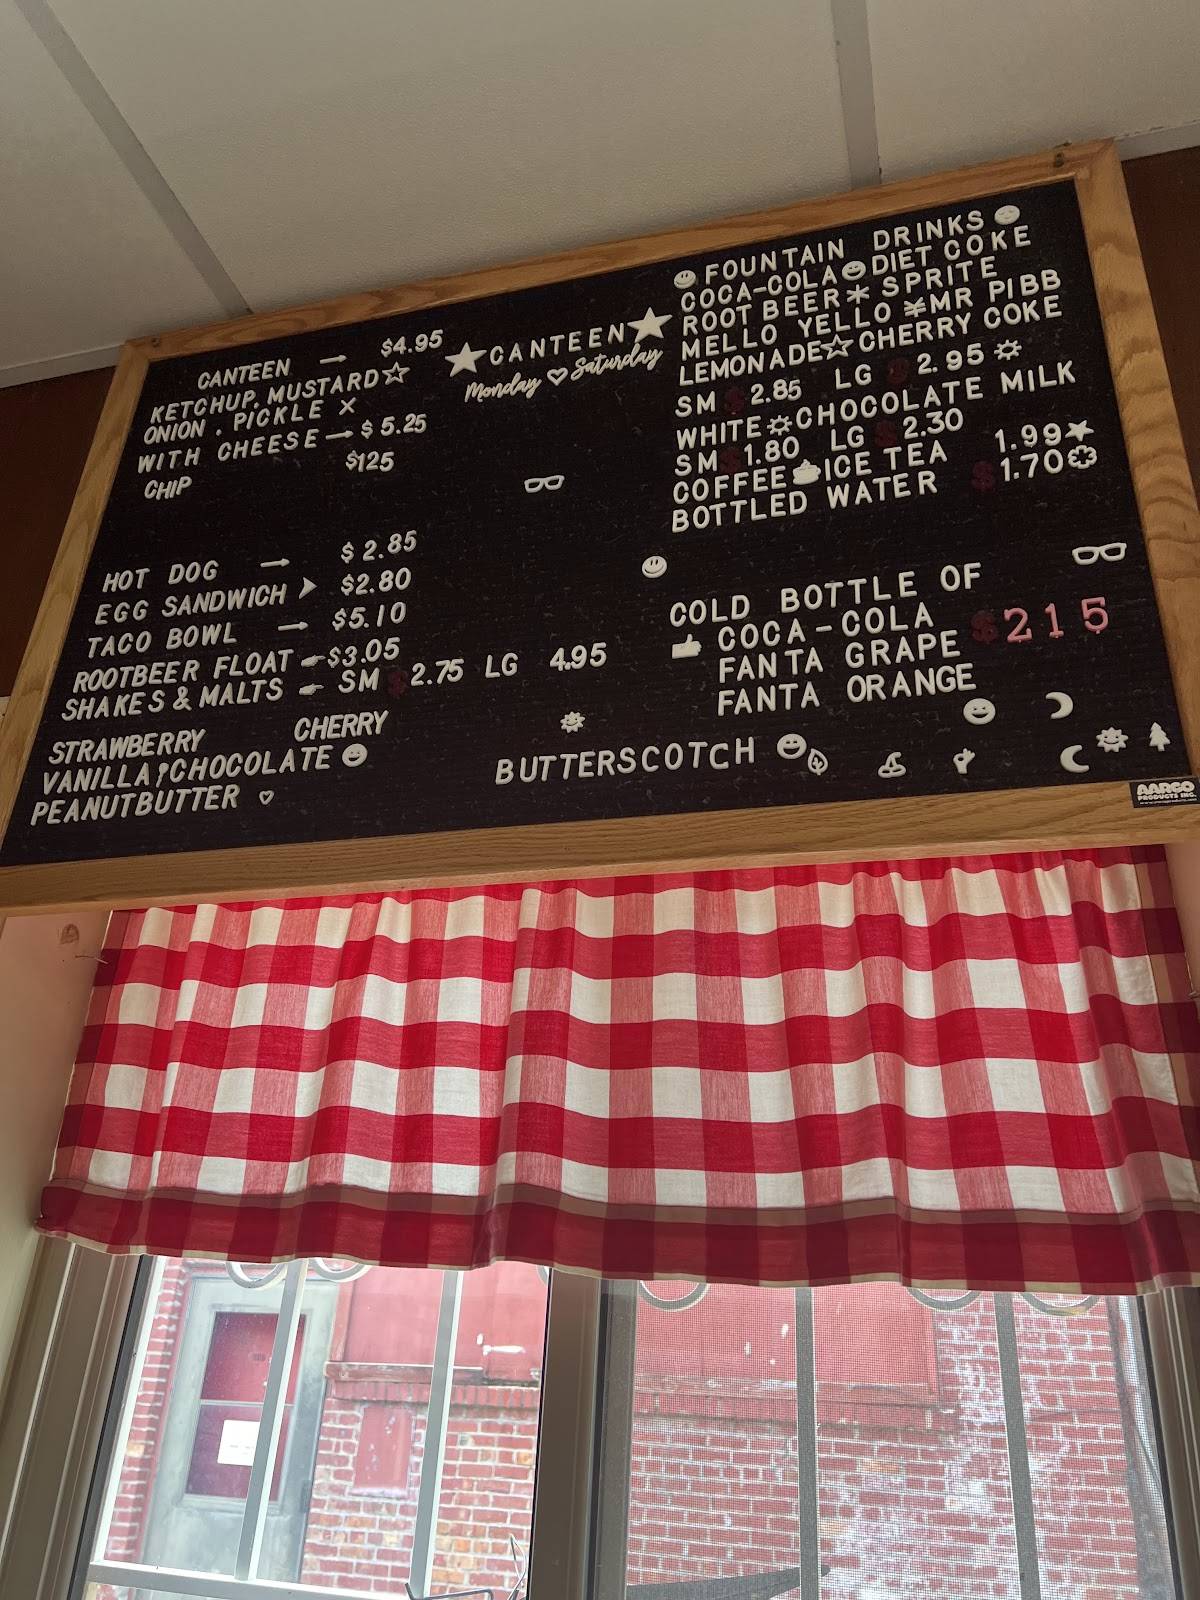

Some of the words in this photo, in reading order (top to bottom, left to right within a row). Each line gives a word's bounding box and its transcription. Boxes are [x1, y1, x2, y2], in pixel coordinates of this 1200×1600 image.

[680, 264, 838, 313] COCA-COLA
[871, 245, 932, 276] DIET
[943, 224, 1031, 261] COKE
[705, 238, 844, 285] FOUNTAIN
[873, 209, 985, 251] DRINKS
[681, 323, 778, 362] MELLO
[797, 301, 892, 338] YELLO
[930, 286, 974, 314] MR
[988, 268, 1061, 303] PIBB
[682, 303, 752, 337] ROOT
[762, 288, 840, 322] BEER
[881, 255, 998, 298] SPRITE
[489, 322, 625, 366] CANTEEN
[679, 340, 823, 387] LEMONADE
[858, 311, 971, 353] CHERRY
[983, 294, 1063, 330] COKE
[197, 358, 291, 390] CANTEEN
[268, 368, 379, 404] MUSTARD
[464, 371, 542, 403] Monday
[570, 342, 663, 382] Saturday
[674, 390, 716, 418] SM
[750, 378, 802, 406] 2.85
[835, 363, 873, 390] LG
[916, 342, 985, 375] 2.95
[143, 419, 206, 445] ONION
[233, 399, 325, 432] PICKLE
[676, 415, 762, 451] WHITE
[795, 376, 984, 430] CHOCOLATE
[1000, 359, 1076, 395] MILK
[137, 446, 201, 474] WITH
[217, 428, 320, 462] CHEESE
[672, 465, 787, 505] COFFEE
[824, 450, 873, 482] ICE
[883, 439, 948, 471] TEA
[994, 422, 1062, 454] 1.99
[674, 449, 718, 477] SM
[743, 435, 800, 467] 1.80
[830, 425, 865, 452] LG
[902, 407, 964, 440] 2.30
[144, 475, 193, 501] CHIP
[671, 490, 808, 533] BOTTLED
[826, 470, 938, 510] WATER
[1000, 448, 1064, 482] 1.70
[102, 566, 151, 594] HOT
[167, 559, 220, 586] DOG
[669, 594, 751, 627] COLD
[780, 570, 918, 614] BOTTLE
[940, 561, 982, 592] OF
[94, 599, 150, 626] EGG
[161, 583, 288, 618] SANDWICH
[716, 600, 935, 652] COCA-COLA
[87, 630, 152, 659] TACO
[165, 622, 238, 650] BOWL
[718, 646, 824, 684] FANTA
[844, 628, 961, 669] GRAPE
[61, 688, 166, 722] SHAKES
[171, 686, 194, 712] &
[199, 677, 284, 709] MALTS
[337, 666, 380, 694] SM
[410, 658, 465, 687] 2.75
[484, 652, 519, 679] LG
[549, 641, 608, 672] 4.95
[72, 658, 201, 694] ROOTBEER
[213, 648, 294, 679] FLOAT
[717, 680, 821, 717] FANTA
[846, 662, 977, 703] ORANGE
[48, 728, 207, 765] STRAWBERRY
[293, 710, 390, 743] CHERRY
[30, 783, 241, 827] PEANUTBUTTER
[494, 736, 756, 785] BUTTERSCOTCH
[42, 762, 150, 795] VANILLA
[169, 744, 335, 782] CHOCOLATE
[1137, 781, 1195, 796] AARCO
